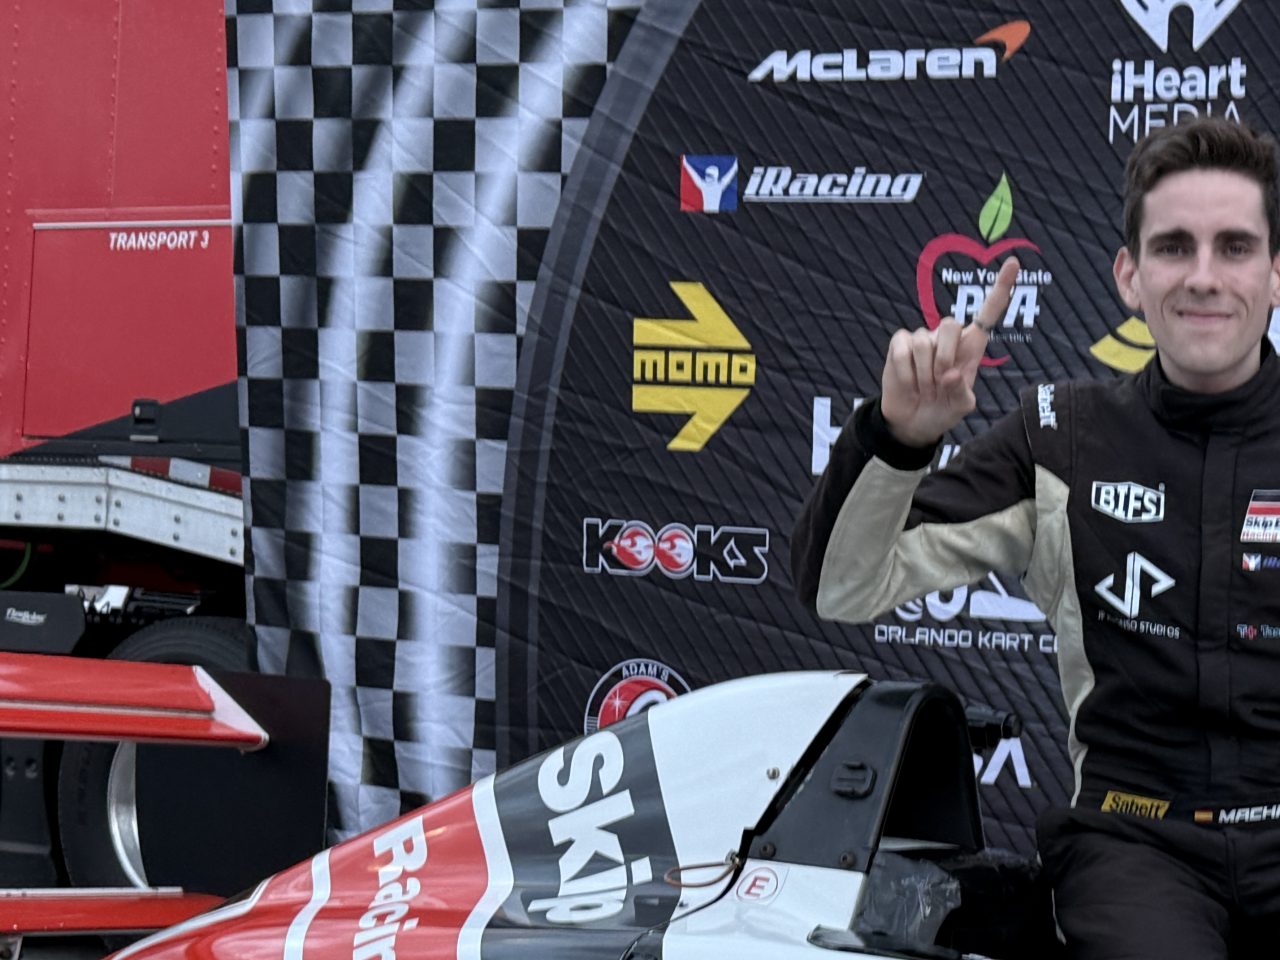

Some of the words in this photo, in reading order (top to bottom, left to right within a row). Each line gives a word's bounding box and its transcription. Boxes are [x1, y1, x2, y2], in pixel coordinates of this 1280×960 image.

[748, 48, 997, 83] McLaren
[1111, 57, 1247, 103] iHeart
[743, 166, 923, 203] iRacing
[109, 231, 198, 251] TRANSPORT
[941, 268, 974, 285] New
[951, 285, 1040, 329] PA
[1245, 517, 1273, 531] Skip
[583, 517, 769, 585] KOOKS
[875, 624, 973, 648] ORLANDO
[978, 631, 1033, 651] KART
[1140, 620, 1180, 639] STUDIOS
[527, 730, 653, 924] Skip
